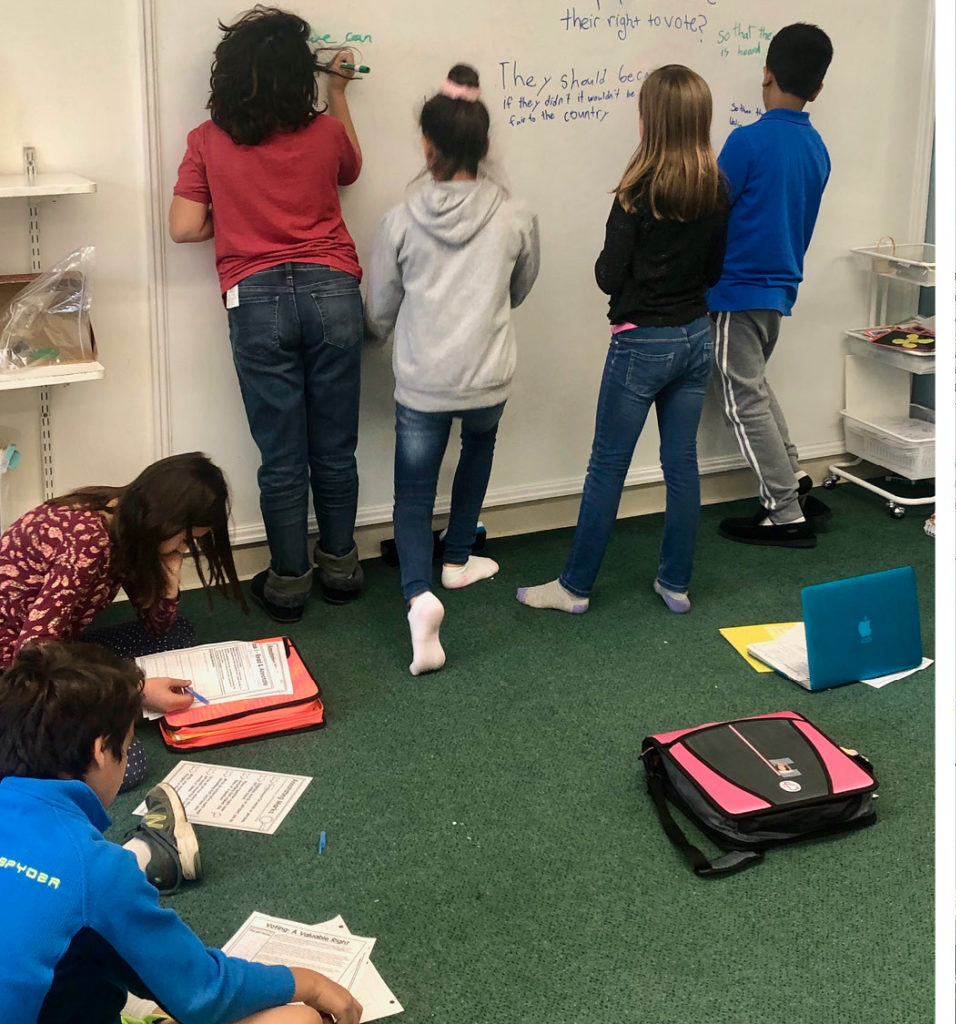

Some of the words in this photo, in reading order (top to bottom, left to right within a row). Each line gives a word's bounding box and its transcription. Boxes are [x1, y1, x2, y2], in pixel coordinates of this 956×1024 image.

[559, 7, 601, 31] their
[607, 13, 641, 41] right
[647, 14, 661, 27] to
[664, 13, 708, 43] vote?
[498, 60, 552, 97] They
[560, 67, 607, 90] should
[563, 106, 609, 123] country
